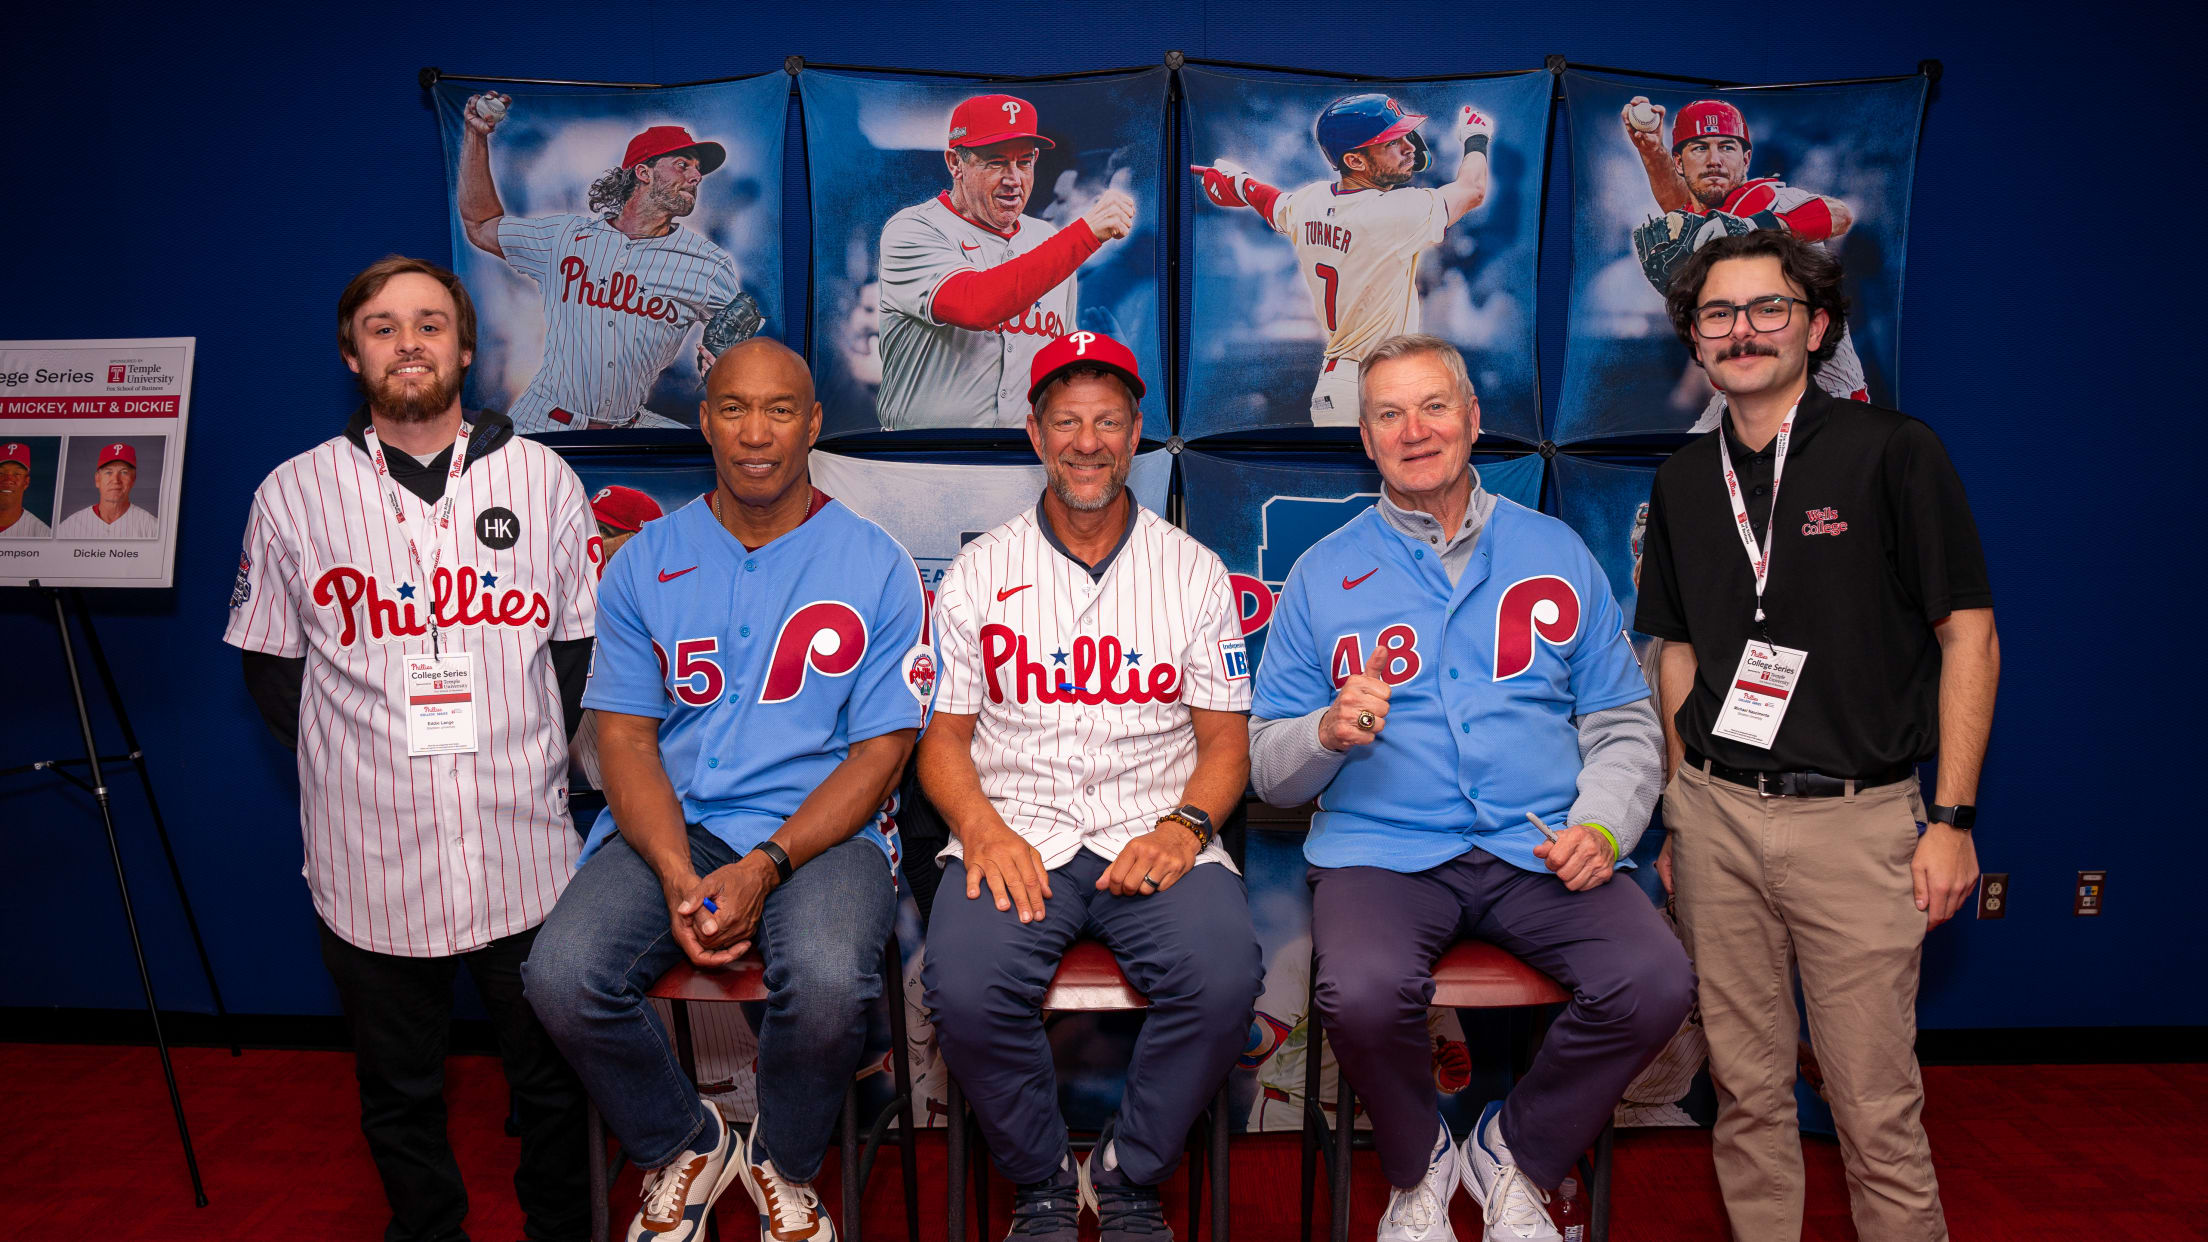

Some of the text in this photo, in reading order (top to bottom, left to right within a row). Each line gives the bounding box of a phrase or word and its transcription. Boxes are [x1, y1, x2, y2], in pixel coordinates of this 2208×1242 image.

[1002, 101, 1021, 124] P
[1705, 115, 1718, 126] 10
[1305, 221, 1352, 254] TURNER
[560, 256, 679, 324] Phillies
[1315, 262, 1339, 331] 7
[1069, 331, 1096, 355] P
[35, 368, 94, 384] Series
[128, 364, 162, 375] Temple
[127, 374, 175, 386] University
[8, 402, 67, 415] MICKEY,
[72, 401, 106, 413] MILT
[109, 401, 120, 413] &
[124, 401, 174, 413] DICKIE
[113, 444, 124, 456] P
[1805, 506, 1839, 522] Wells
[484, 518, 514, 538] HK
[1801, 519, 1848, 536] College
[73, 548, 139, 559] Dickie Noles
[313, 565, 551, 647] Phillies
[1492, 574, 1581, 682] P
[757, 600, 868, 704] P
[1331, 623, 1423, 692] 48
[980, 623, 1184, 706] Phillie
[1747, 657, 1773, 670] College
[1773, 663, 1795, 675] Series
[411, 669, 468, 680] College Series
